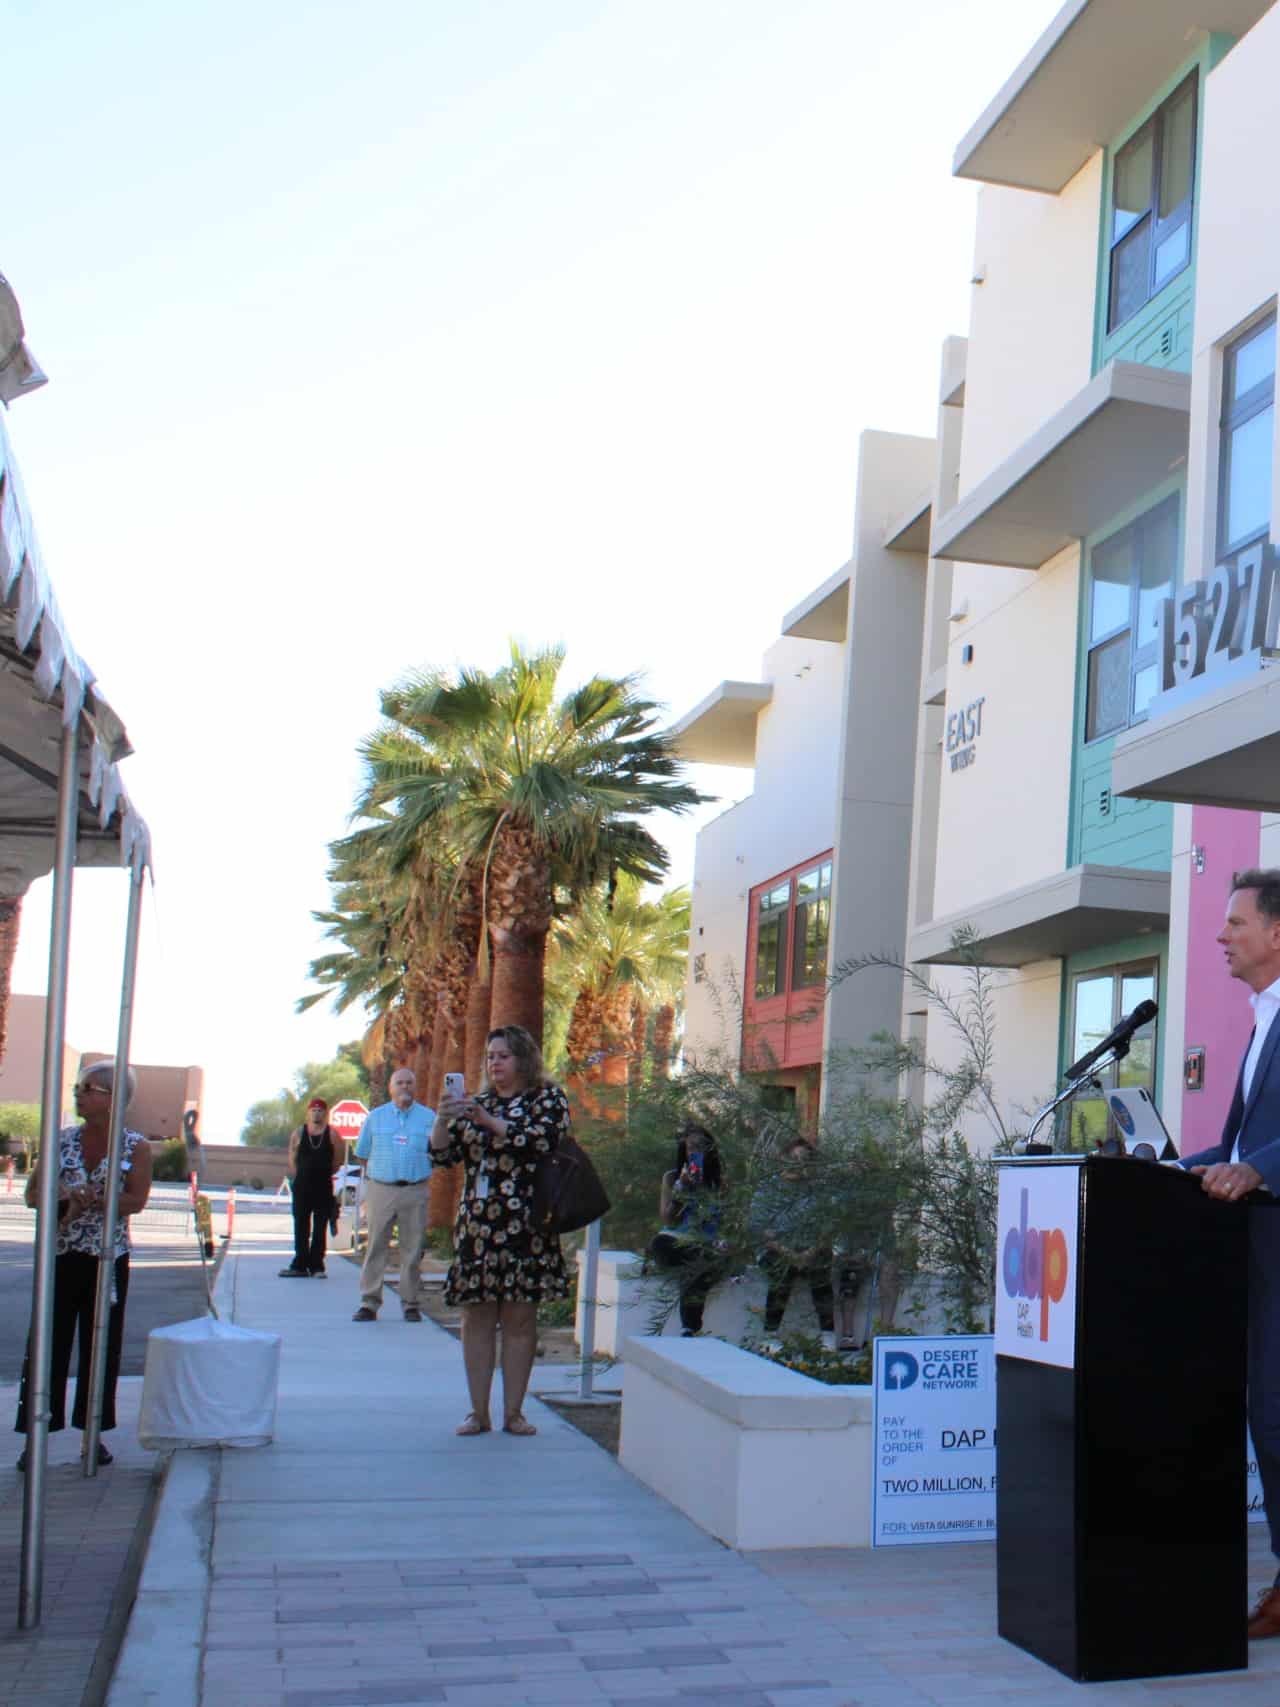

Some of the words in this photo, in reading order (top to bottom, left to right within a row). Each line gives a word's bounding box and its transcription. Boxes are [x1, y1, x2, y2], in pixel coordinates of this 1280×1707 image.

[944, 696, 985, 752] EAST
[923, 1350, 978, 1362] DESERT
[922, 1363, 978, 1379] CARE
[922, 1380, 977, 1390] NETWORK
[883, 1416, 906, 1426] PAY
[883, 1430, 898, 1440] TO
[941, 1429, 986, 1449] DAP
[882, 1442, 924, 1453] ORDER
[882, 1479, 919, 1493] TWO
[923, 1477, 986, 1492] MILLION,
[911, 1521, 936, 1531] VISTA
[937, 1519, 976, 1530] SUNRISE
